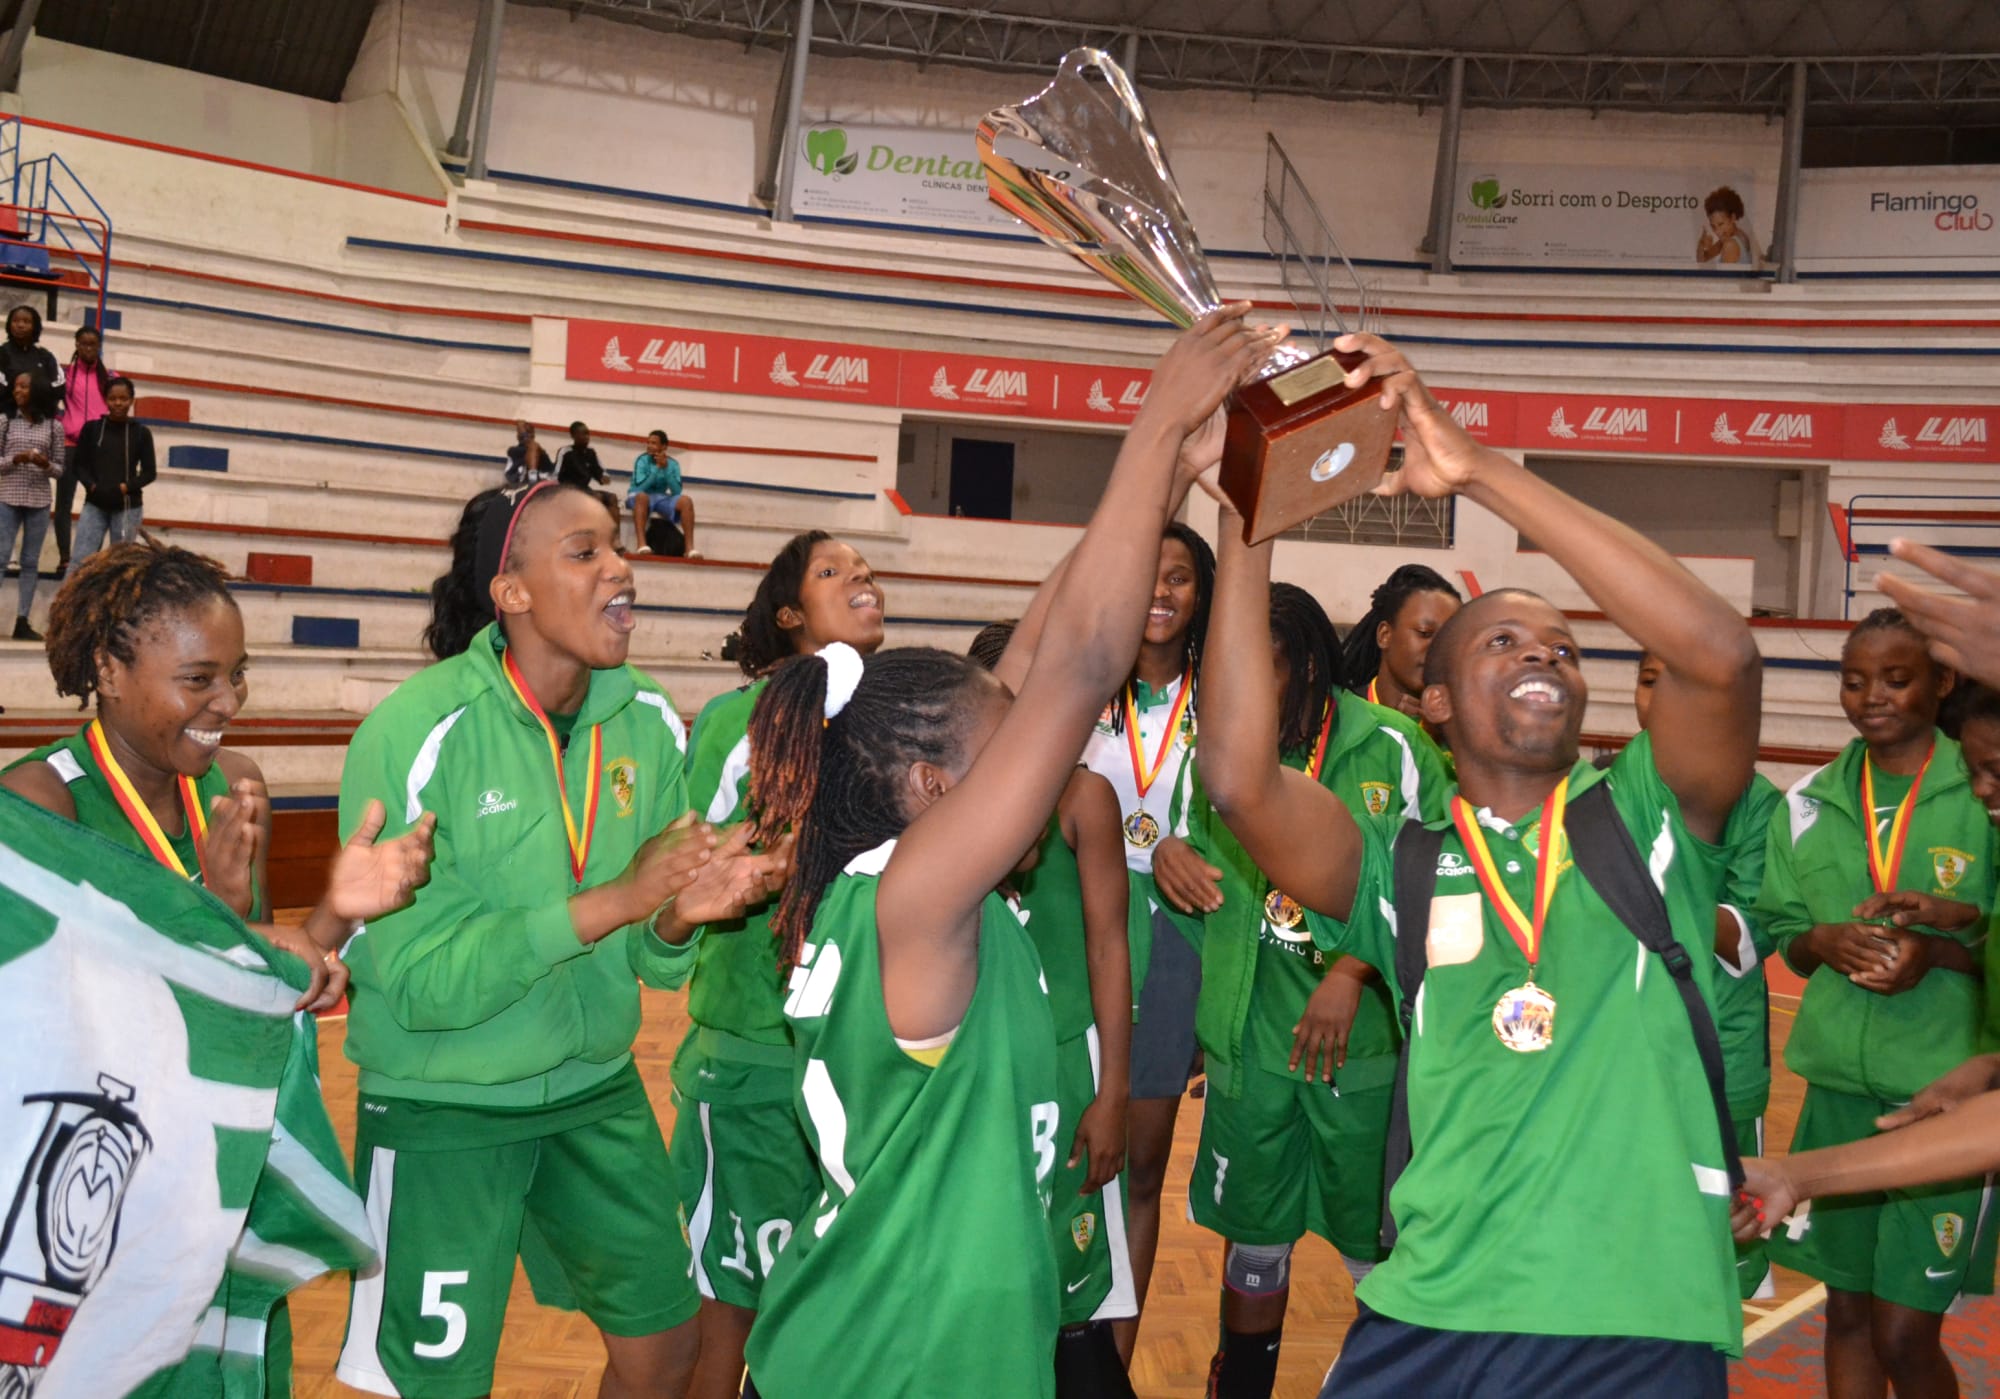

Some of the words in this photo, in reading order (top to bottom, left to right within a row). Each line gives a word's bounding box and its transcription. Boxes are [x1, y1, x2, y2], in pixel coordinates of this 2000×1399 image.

[1511, 189, 1555, 207] Sorri
[1560, 193, 1597, 208] com
[1602, 195, 1612, 208] o
[1617, 191, 1699, 212] Desporto
[1870, 191, 1978, 215] Flamingo
[1935, 208, 1994, 231] Club
[413, 1270, 469, 1358] 5
